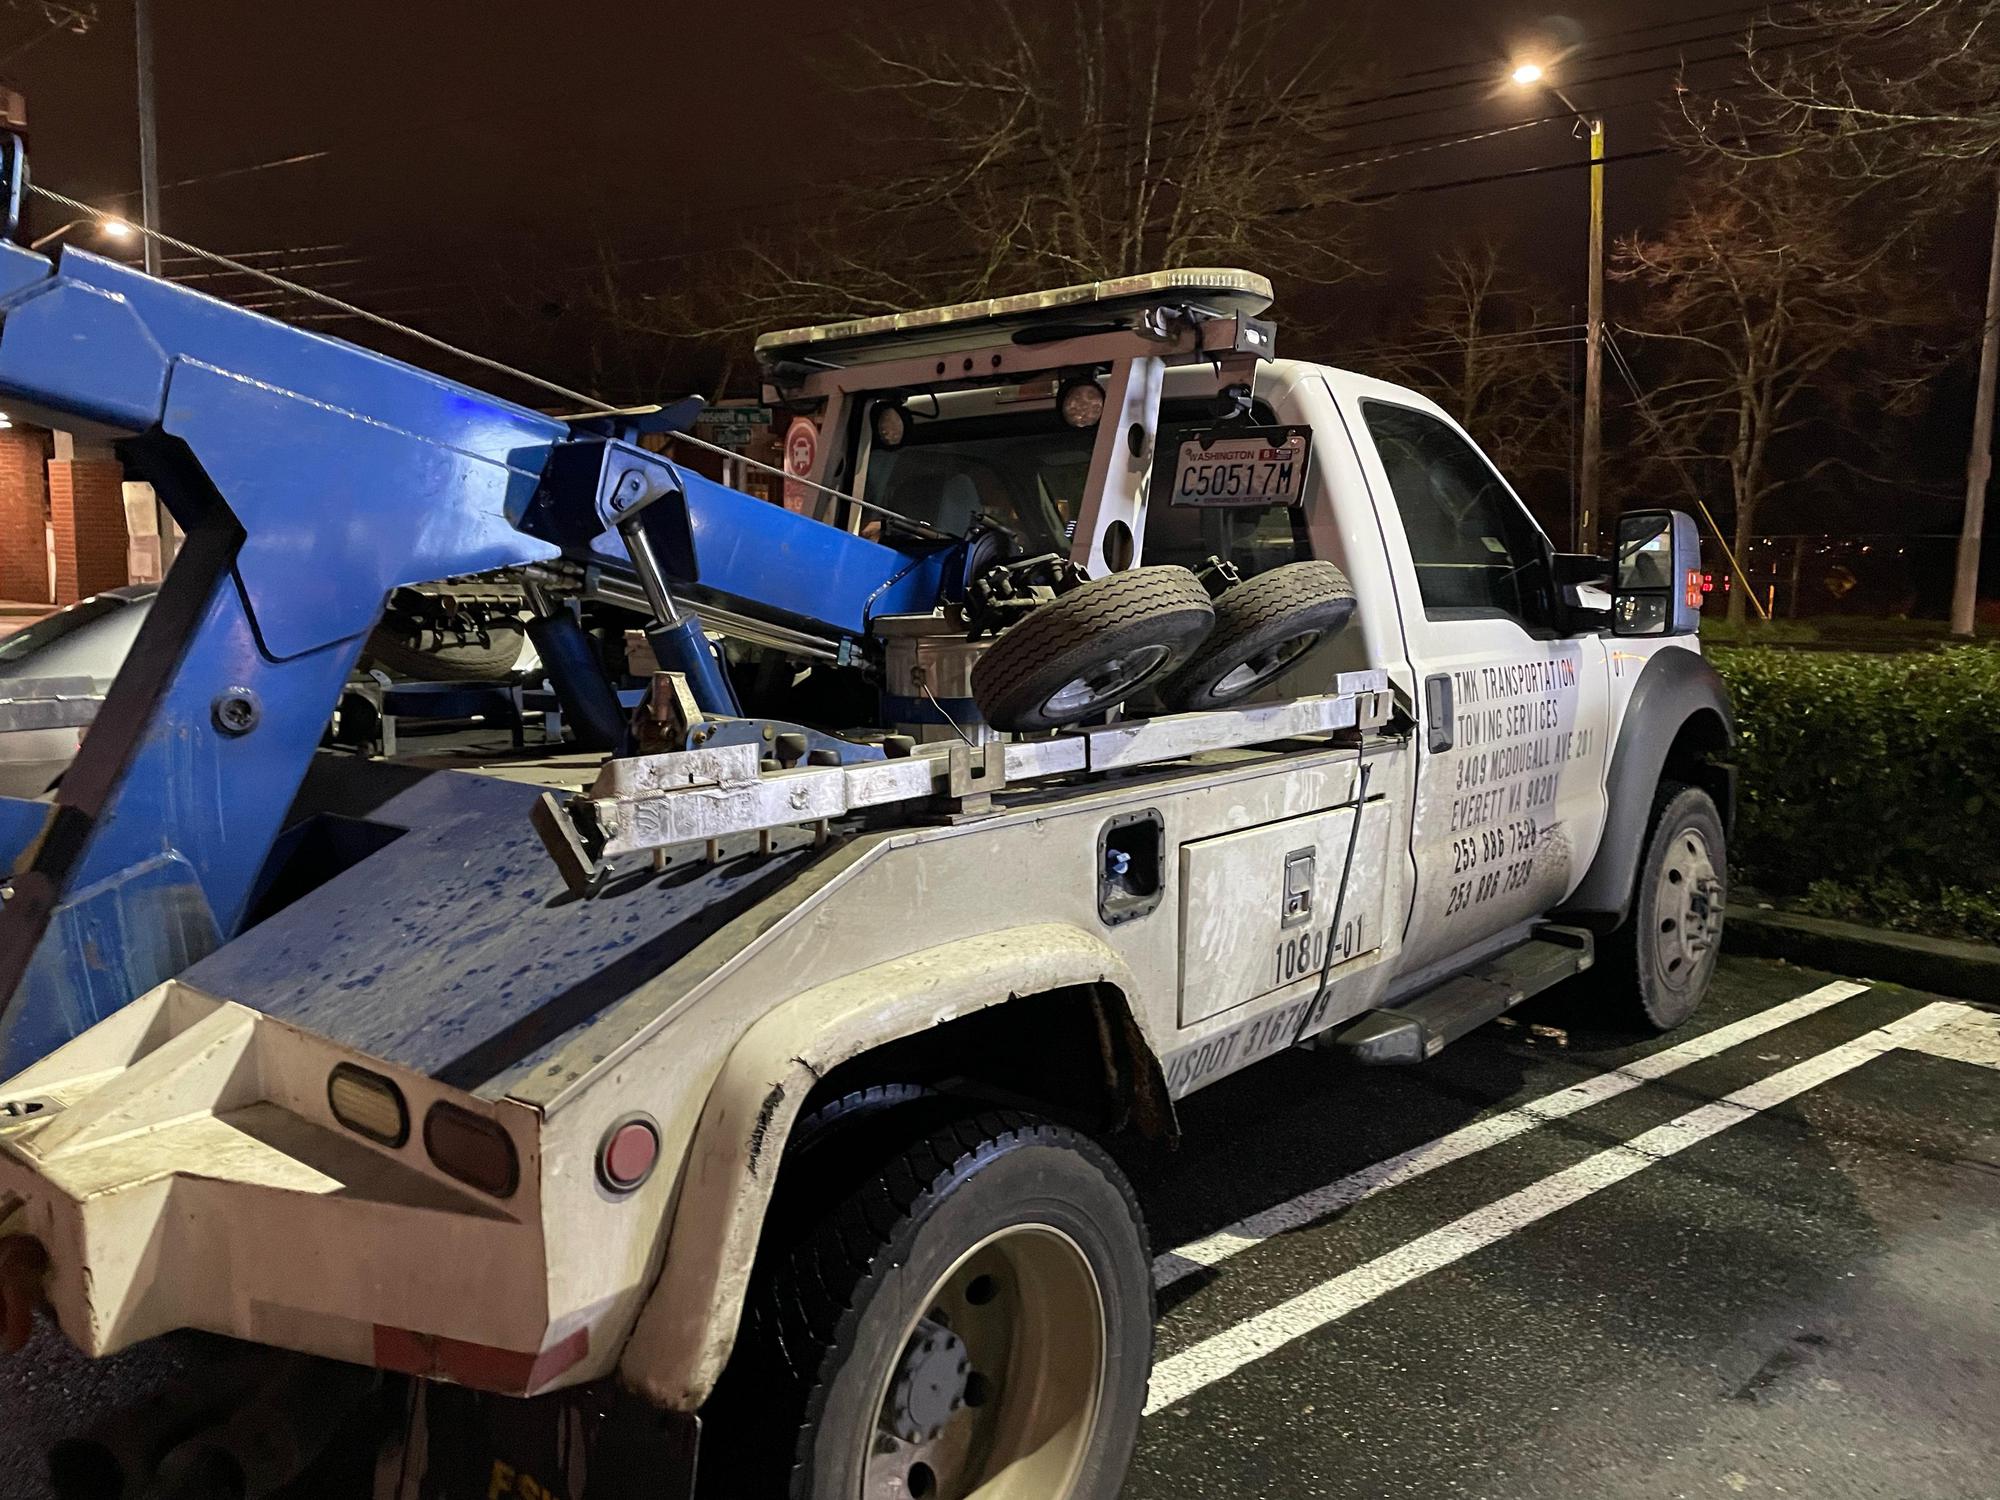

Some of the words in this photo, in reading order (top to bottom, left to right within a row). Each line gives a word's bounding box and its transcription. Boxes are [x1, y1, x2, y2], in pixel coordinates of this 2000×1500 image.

[1181, 462, 1293, 496] C50517M
[1189, 450, 1254, 461] WASHINGTON
[1455, 669, 1478, 705] TMK
[1482, 658, 1576, 699] TRANSPORTATION
[1458, 708, 1502, 748] TOWING
[1506, 699, 1558, 737] SERVICES
[1456, 753, 1487, 791] 3409
[1490, 738, 1550, 782] MCDOUGALL
[1554, 731, 1574, 763] AVE
[1575, 728, 1594, 758] 201
[1451, 787, 1505, 832] EVERETT
[1526, 772, 1560, 809] 98201
[1453, 836, 1476, 875] 253
[1482, 827, 1504, 863] 886
[1508, 817, 1536, 855] 7528
[1445, 879, 1472, 917] 253
[1475, 870, 1500, 904] 886
[1502, 858, 1533, 894] 7529
[1275, 914, 1363, 984] 1080-01
[1167, 1030, 1241, 1089] USDOT
